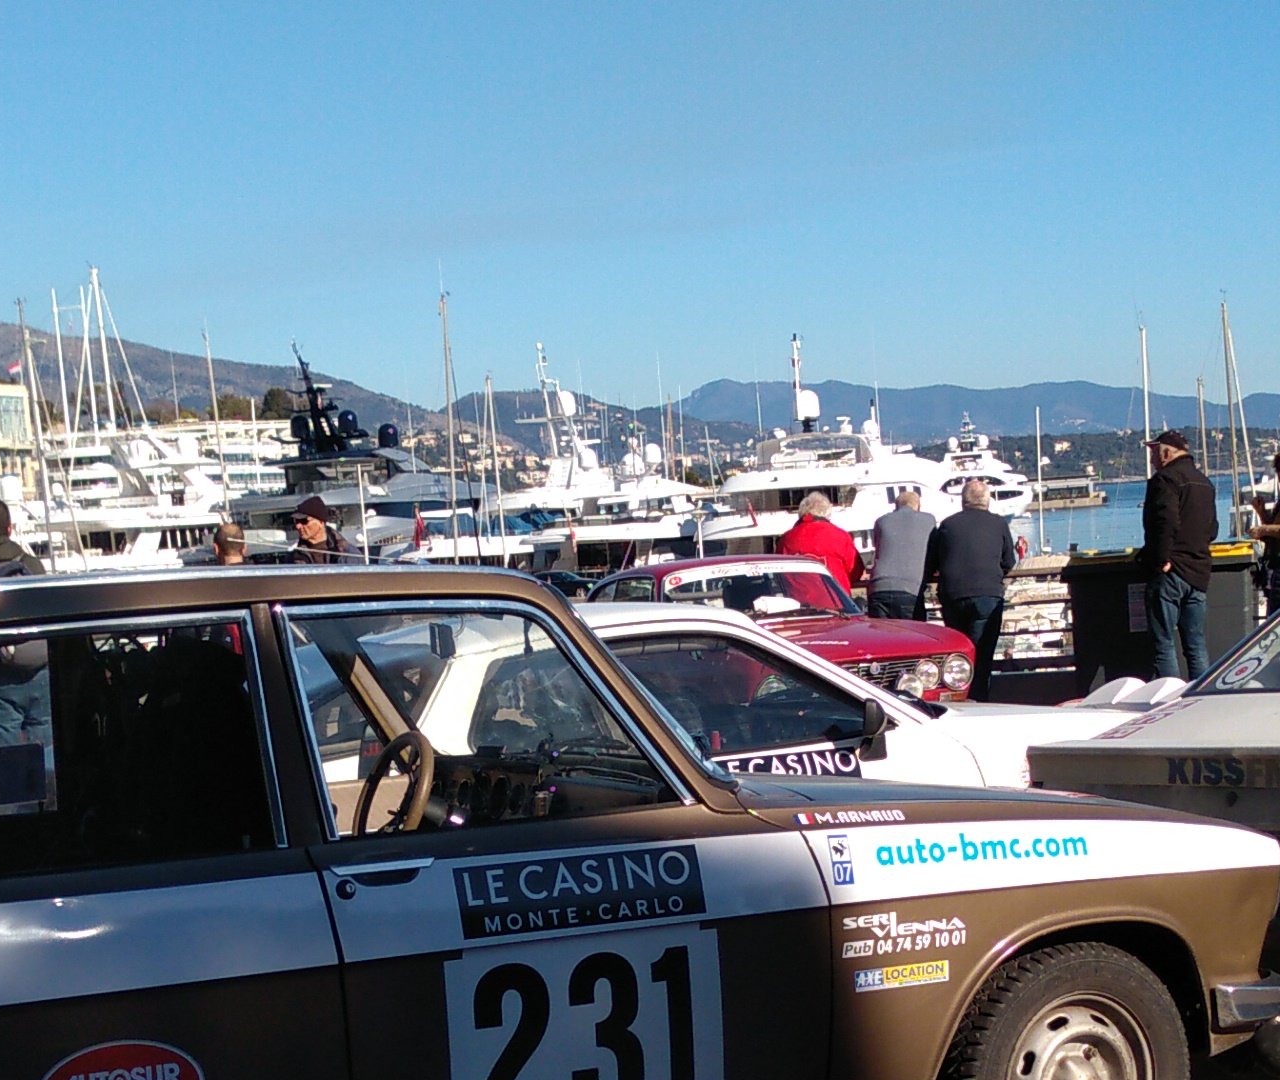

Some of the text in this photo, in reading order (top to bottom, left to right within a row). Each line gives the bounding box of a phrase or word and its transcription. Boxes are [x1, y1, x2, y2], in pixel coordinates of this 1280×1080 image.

[875, 833, 1089, 866] auto-bmc.com
[462, 850, 691, 907] LE CASINO
[833, 863, 853, 884] 07
[844, 930, 966, 955] Pub 04 74 59 10 01
[856, 971, 883, 987] AXE
[885, 962, 945, 980] LOCATION
